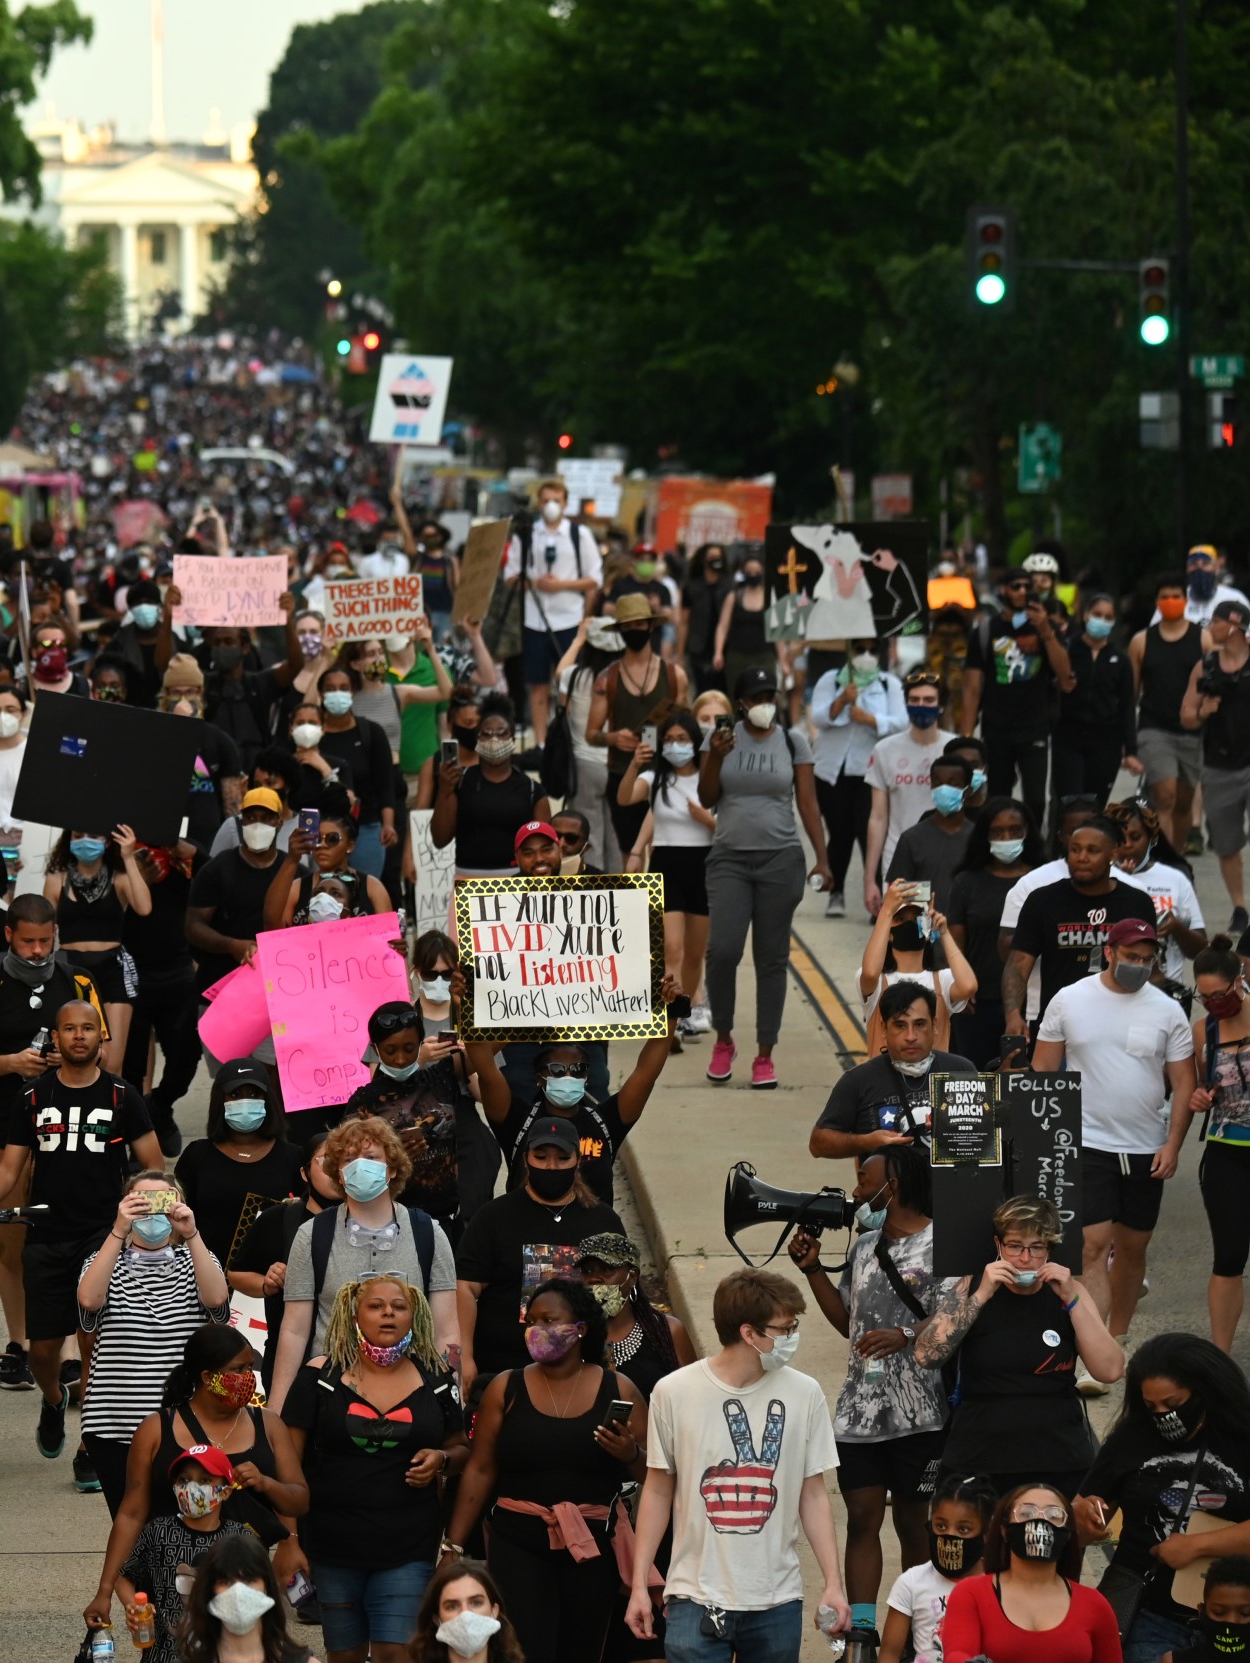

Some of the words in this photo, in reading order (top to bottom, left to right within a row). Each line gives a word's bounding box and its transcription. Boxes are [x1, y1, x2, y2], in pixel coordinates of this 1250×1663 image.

[325, 582, 373, 599] THERE
[375, 578, 390, 594] IS
[393, 576, 421, 596] NO
[333, 600, 372, 617] SUCH
[372, 597, 421, 615] THING
[327, 624, 344, 639] AS
[346, 621, 357, 636] A
[358, 618, 393, 634] GOOD
[895, 774, 913, 785] DO
[470, 894, 507, 923] IF
[580, 891, 620, 928] not
[1058, 924, 1094, 932] WORLD
[275, 939, 403, 997] Silence
[475, 953, 511, 982] not
[519, 953, 618, 993] Listening
[330, 1004, 359, 1035] is
[944, 1080, 987, 1093] FREEDOM
[1008, 1074, 1081, 1093] FOLLOW
[955, 1092, 976, 1104] DAY
[948, 1104, 984, 1117] MARCH
[1031, 1096, 1062, 1118] US
[36, 1106, 113, 1153] BIC
[68, 1124, 79, 1133] IN
[757, 1201, 778, 1210] PYLE
[1024, 1522, 1054, 1537] BLACK
[936, 1536, 964, 1551] BLACK
[1024, 1533, 1055, 1547] LIVES
[937, 1549, 963, 1562] LIVES
[1025, 1545, 1052, 1558] MATTER
[938, 1559, 963, 1571] MATTER
[1215, 1635, 1240, 1644] CAN'T
